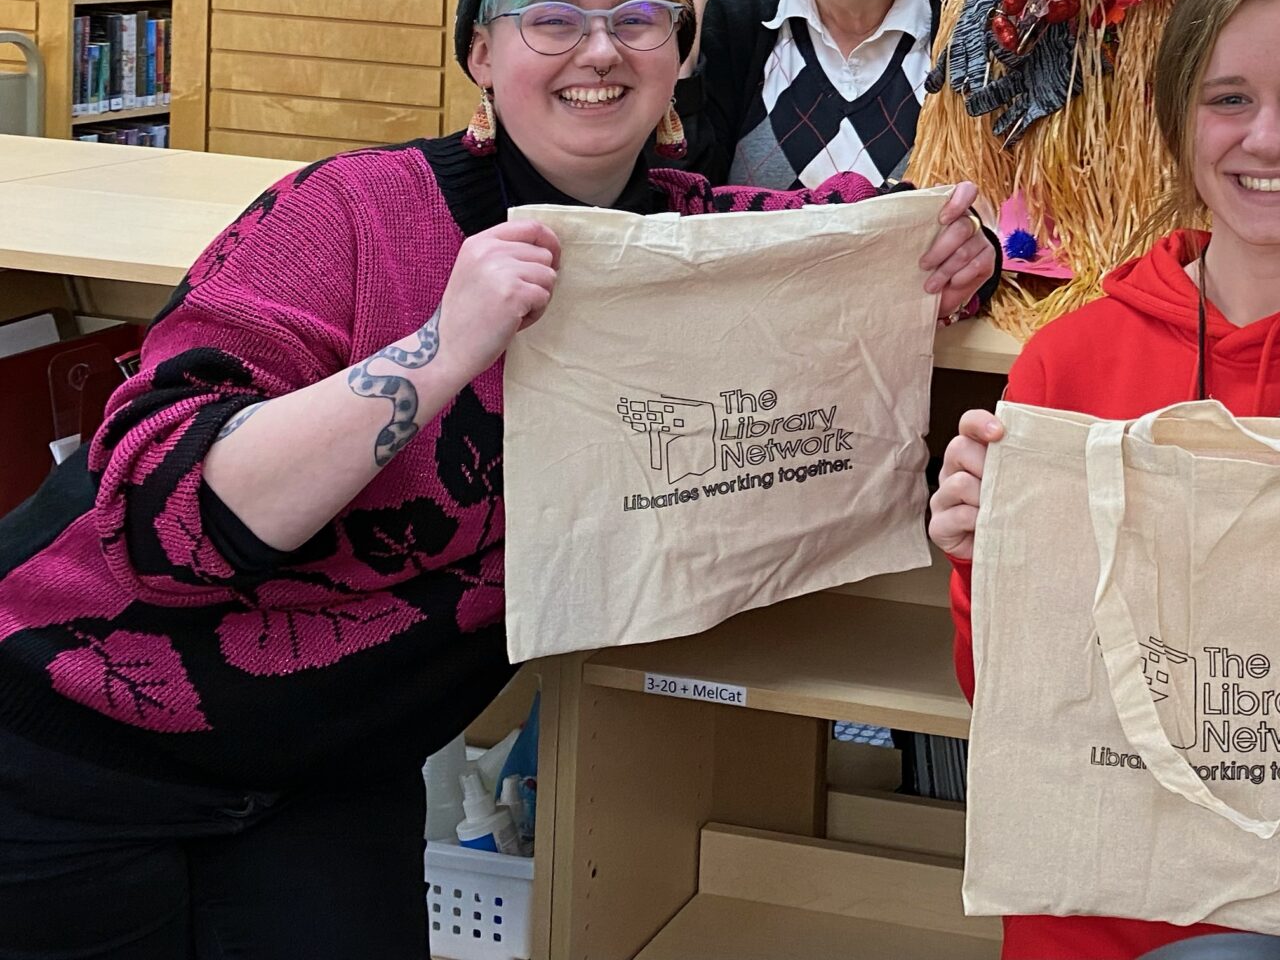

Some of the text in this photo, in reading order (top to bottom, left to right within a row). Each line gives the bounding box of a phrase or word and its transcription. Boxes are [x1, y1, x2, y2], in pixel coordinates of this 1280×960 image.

[720, 389, 777, 414] The
[720, 406, 836, 440] Library
[721, 429, 853, 471] Network
[623, 458, 853, 511] Libraries working together.
[1203, 646, 1271, 679] The
[647, 677, 742, 703] 3-20 + MelCat
[1090, 746, 1147, 770] Libra
[1188, 760, 1266, 785] orking
